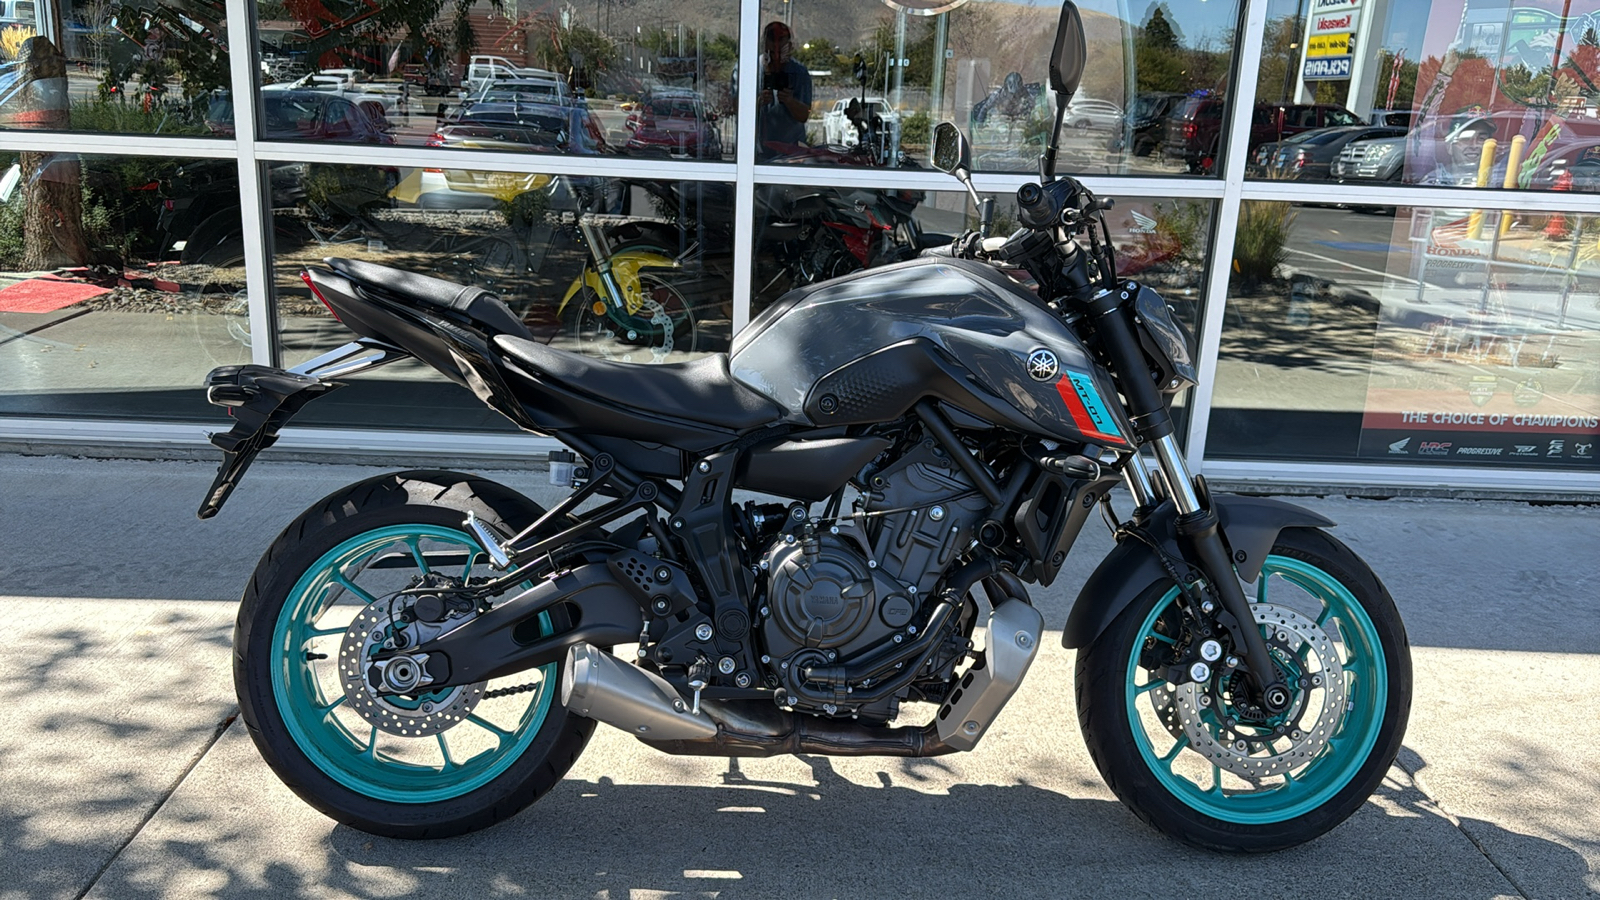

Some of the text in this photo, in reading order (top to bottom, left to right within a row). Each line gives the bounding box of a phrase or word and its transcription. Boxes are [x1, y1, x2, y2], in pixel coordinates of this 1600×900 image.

[1426, 246, 1481, 257] HONDA
[1426, 260, 1476, 269] PROGRESSIVE
[438, 320, 470, 338] YAMAHA
[1073, 379, 1104, 425] MT-07
[1401, 411, 1599, 429] THE CHOICE OF CHAMPIONS
[1418, 441, 1452, 453] HRC
[1456, 447, 1504, 456] PROGRESSIVE
[810, 595, 839, 605] YAMAHA
